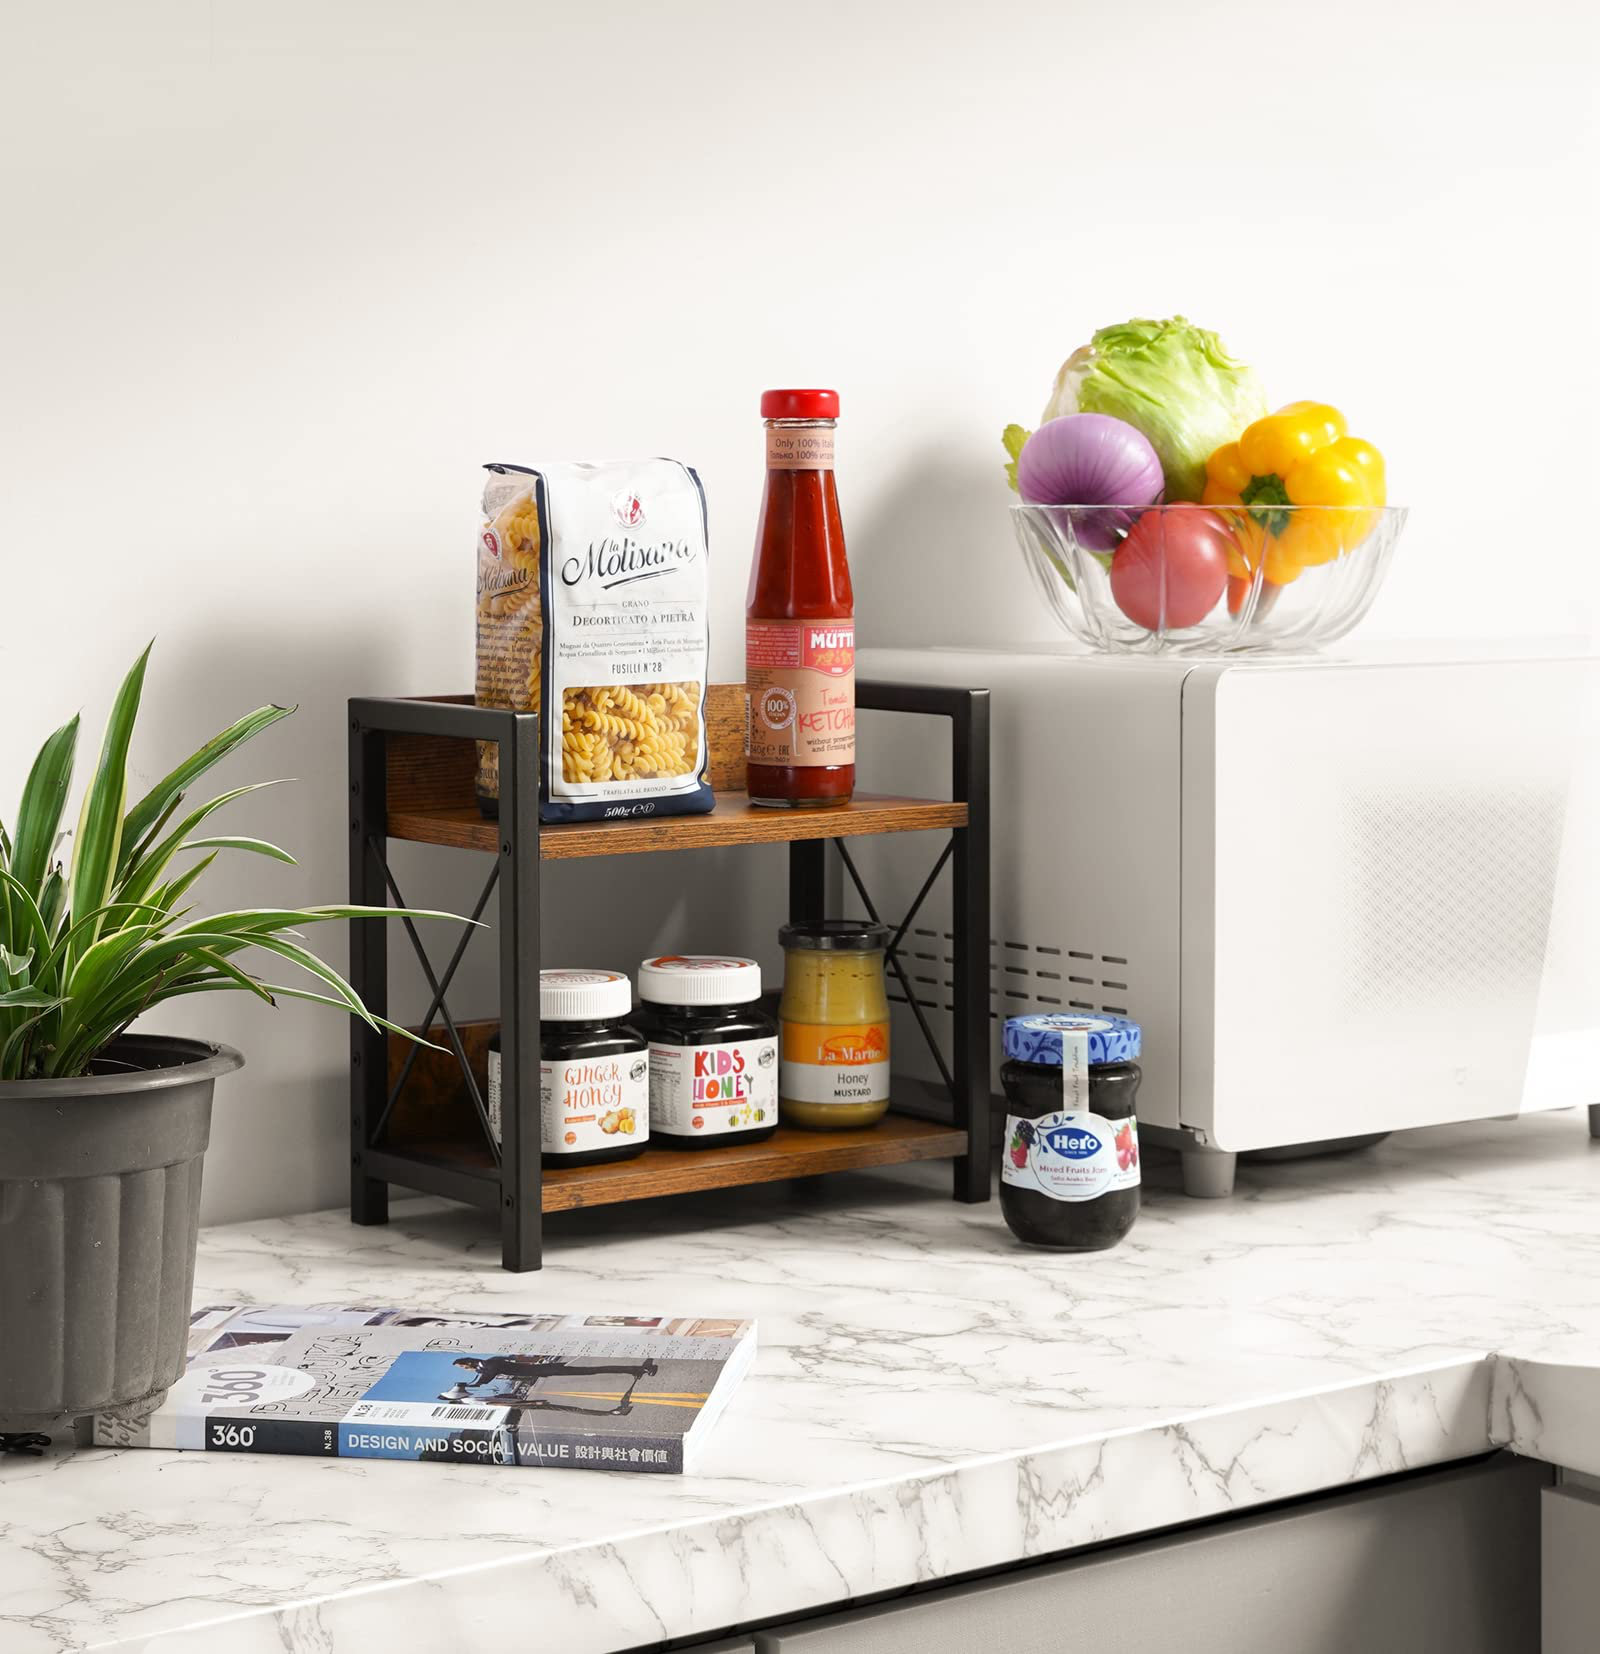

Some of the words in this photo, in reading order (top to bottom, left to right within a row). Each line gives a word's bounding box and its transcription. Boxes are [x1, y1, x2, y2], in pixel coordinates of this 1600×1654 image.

[775, 438, 794, 450] Only
[572, 614, 649, 627] DECORTICATO
[660, 610, 696, 623] PIETRA
[611, 663, 641, 675] FUSILLI
[806, 736, 833, 746] without
[811, 744, 826, 753] and
[817, 1046, 836, 1061] La
[694, 1048, 745, 1078] KIDS
[565, 1063, 623, 1086] GINGER
[837, 1073, 869, 1086] Honey
[692, 1073, 754, 1102] HONEY
[833, 1087, 872, 1098] MUSTARD
[563, 1084, 623, 1110] HONEY
[1053, 1134, 1098, 1150] Hero
[1039, 1164, 1064, 1175] Mixed
[1065, 1164, 1090, 1175] Fruits
[353, 1403, 374, 1418] N.38
[211, 1424, 257, 1447] 360°
[324, 1429, 332, 1450] N.38
[348, 1433, 410, 1451] DESIGN
[413, 1437, 449, 1453] AND
[452, 1439, 513, 1455] SOCIAL
[517, 1443, 570, 1459] VALUE
[574, 1445, 668, 1464] 設計與社會價值
